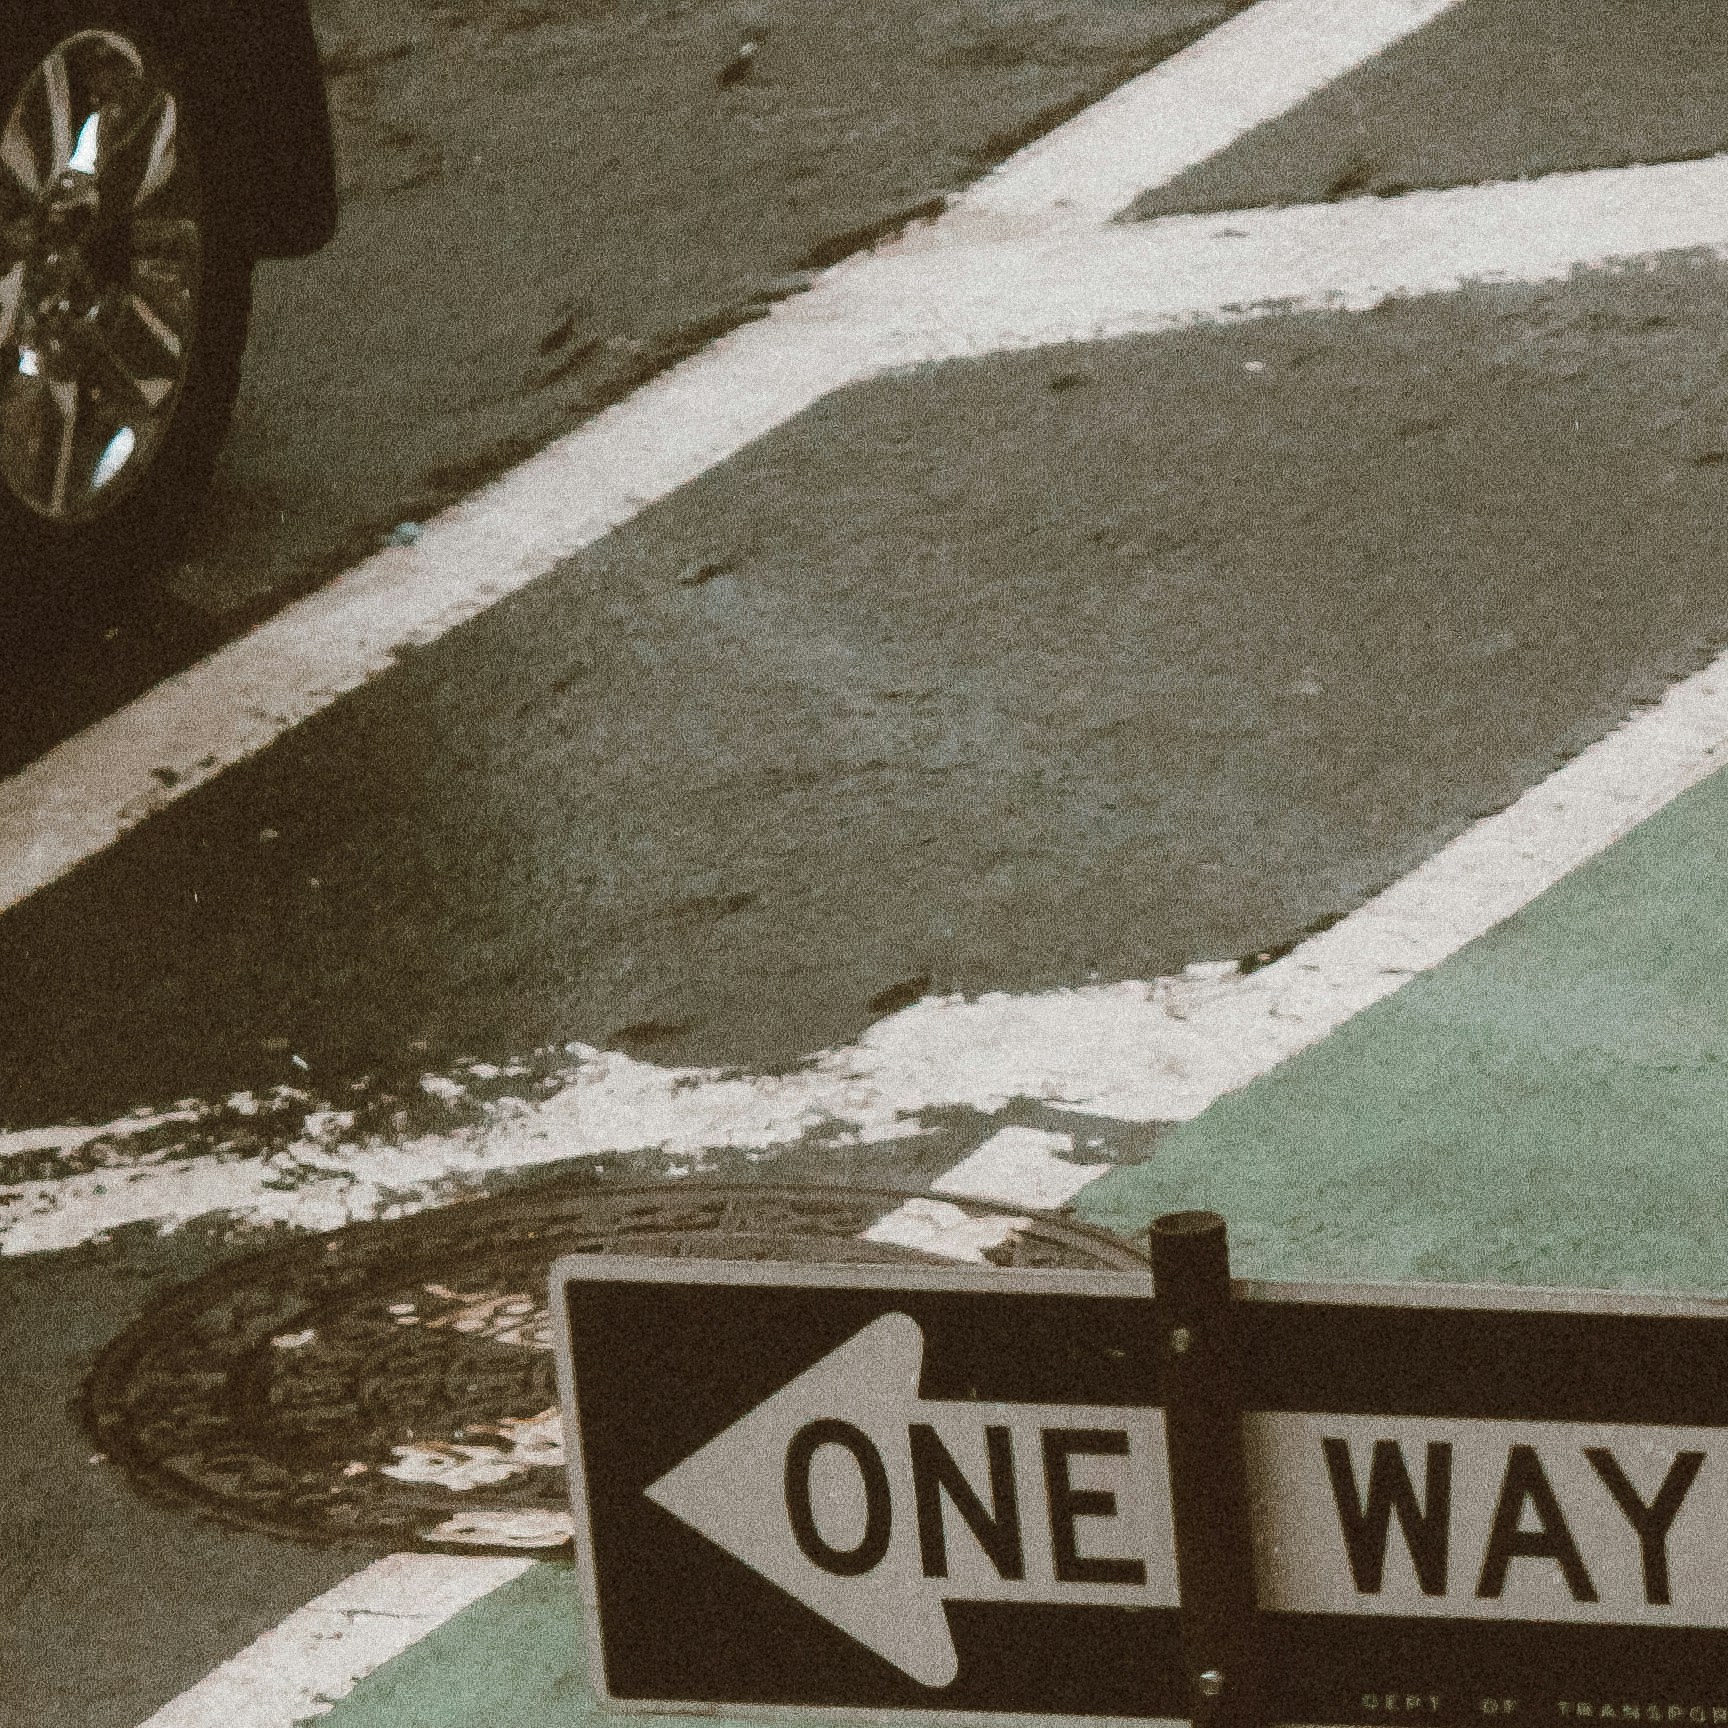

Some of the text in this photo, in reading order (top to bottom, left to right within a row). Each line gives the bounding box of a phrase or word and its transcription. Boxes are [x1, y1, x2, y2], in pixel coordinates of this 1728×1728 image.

[784, 1418, 1704, 1606] ONE WAY
[1361, 1693, 1440, 1712] DEPT
[1481, 1697, 1517, 1715] OF
